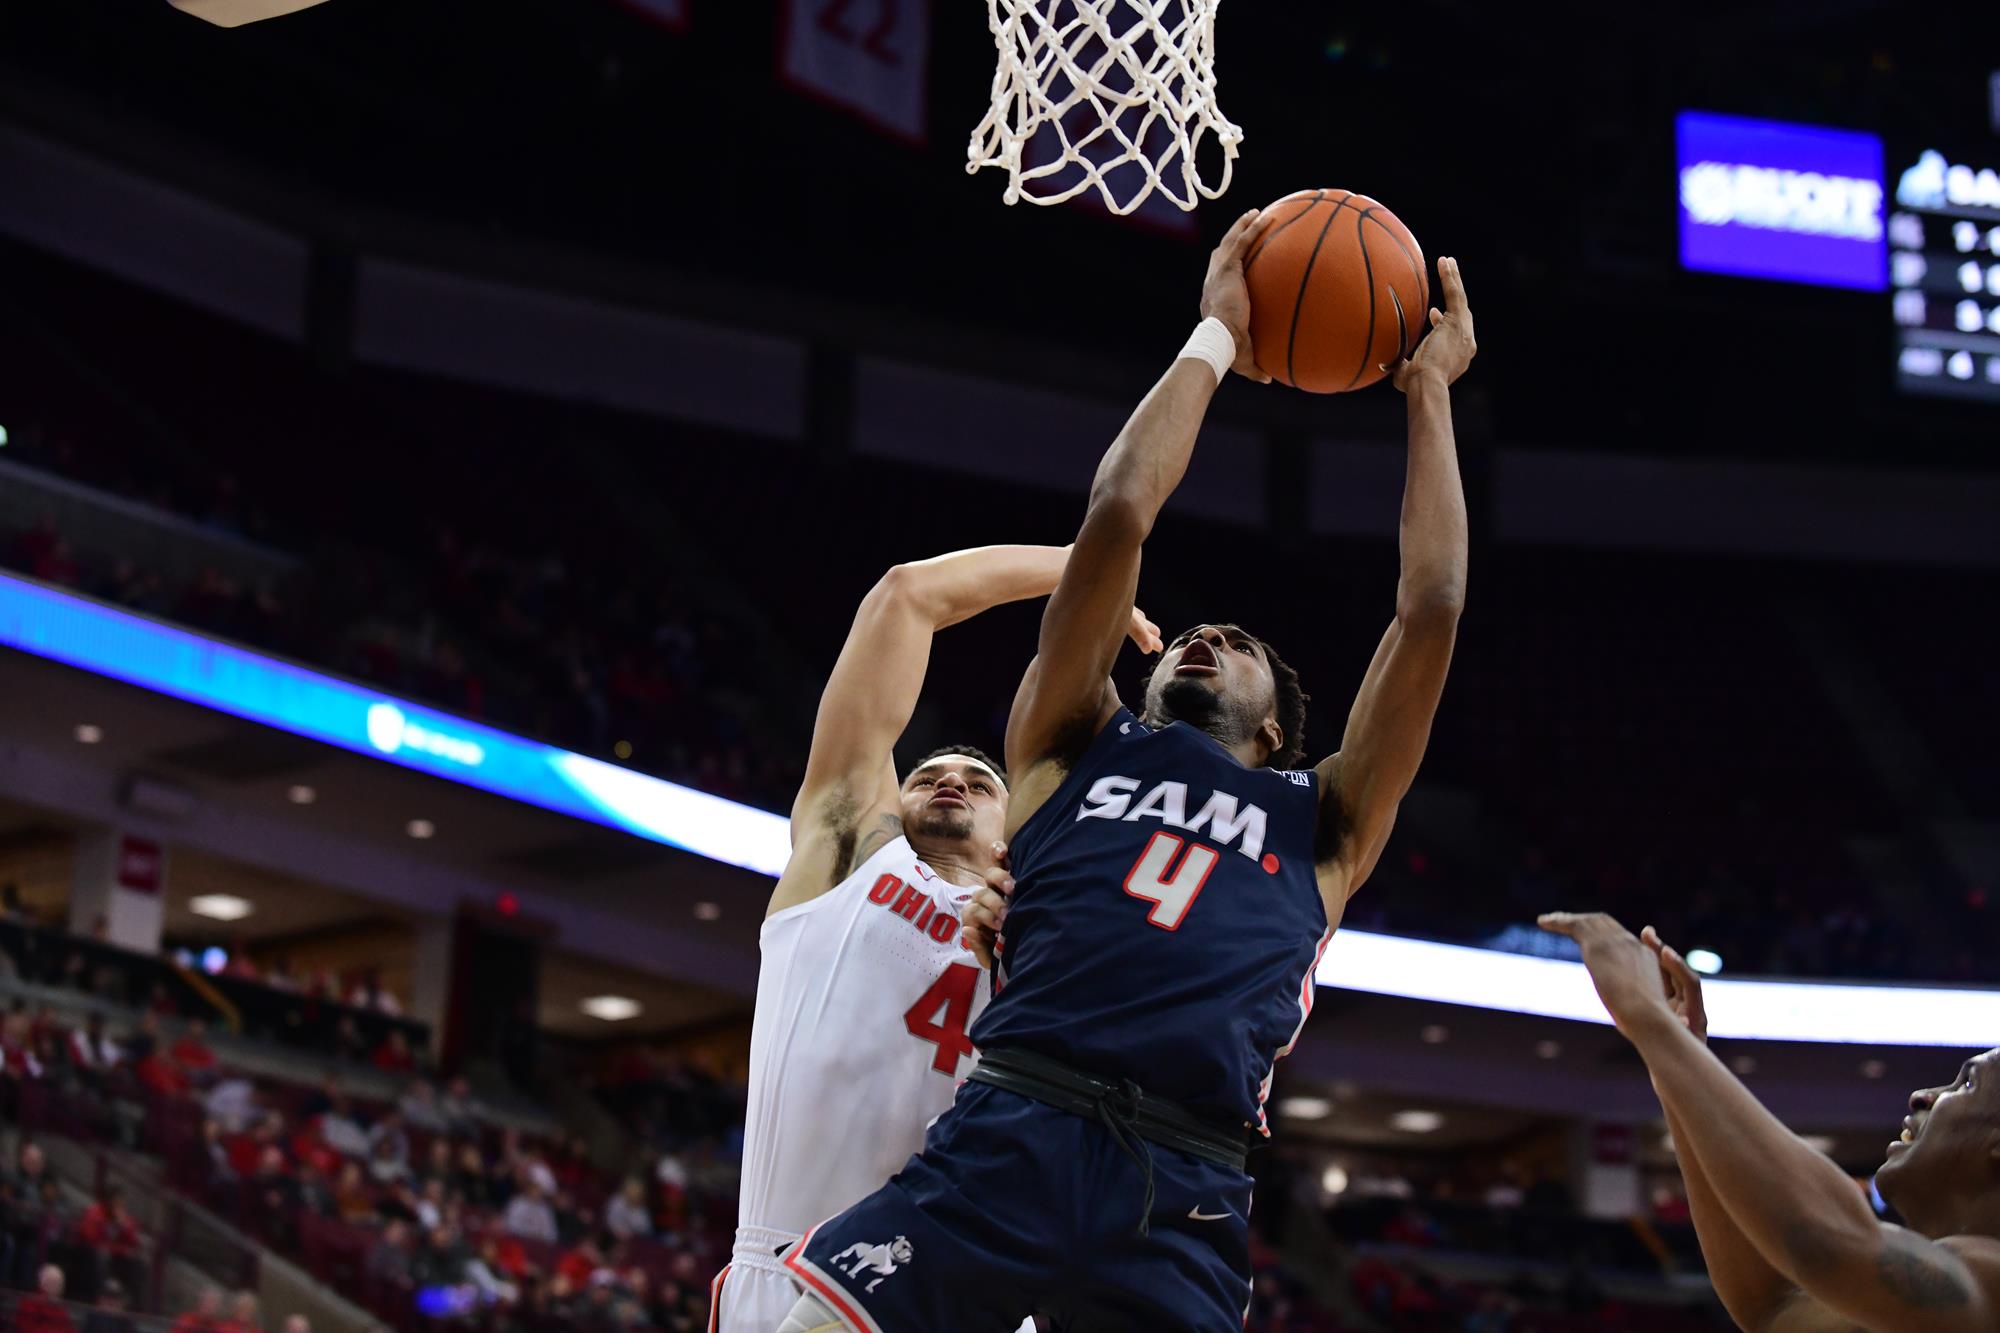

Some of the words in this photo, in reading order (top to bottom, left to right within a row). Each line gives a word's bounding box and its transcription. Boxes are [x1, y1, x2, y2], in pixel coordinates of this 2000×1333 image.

[867, 873, 960, 944] OHIO
[1122, 831, 1220, 932] 4
[903, 961, 975, 1079] 4
